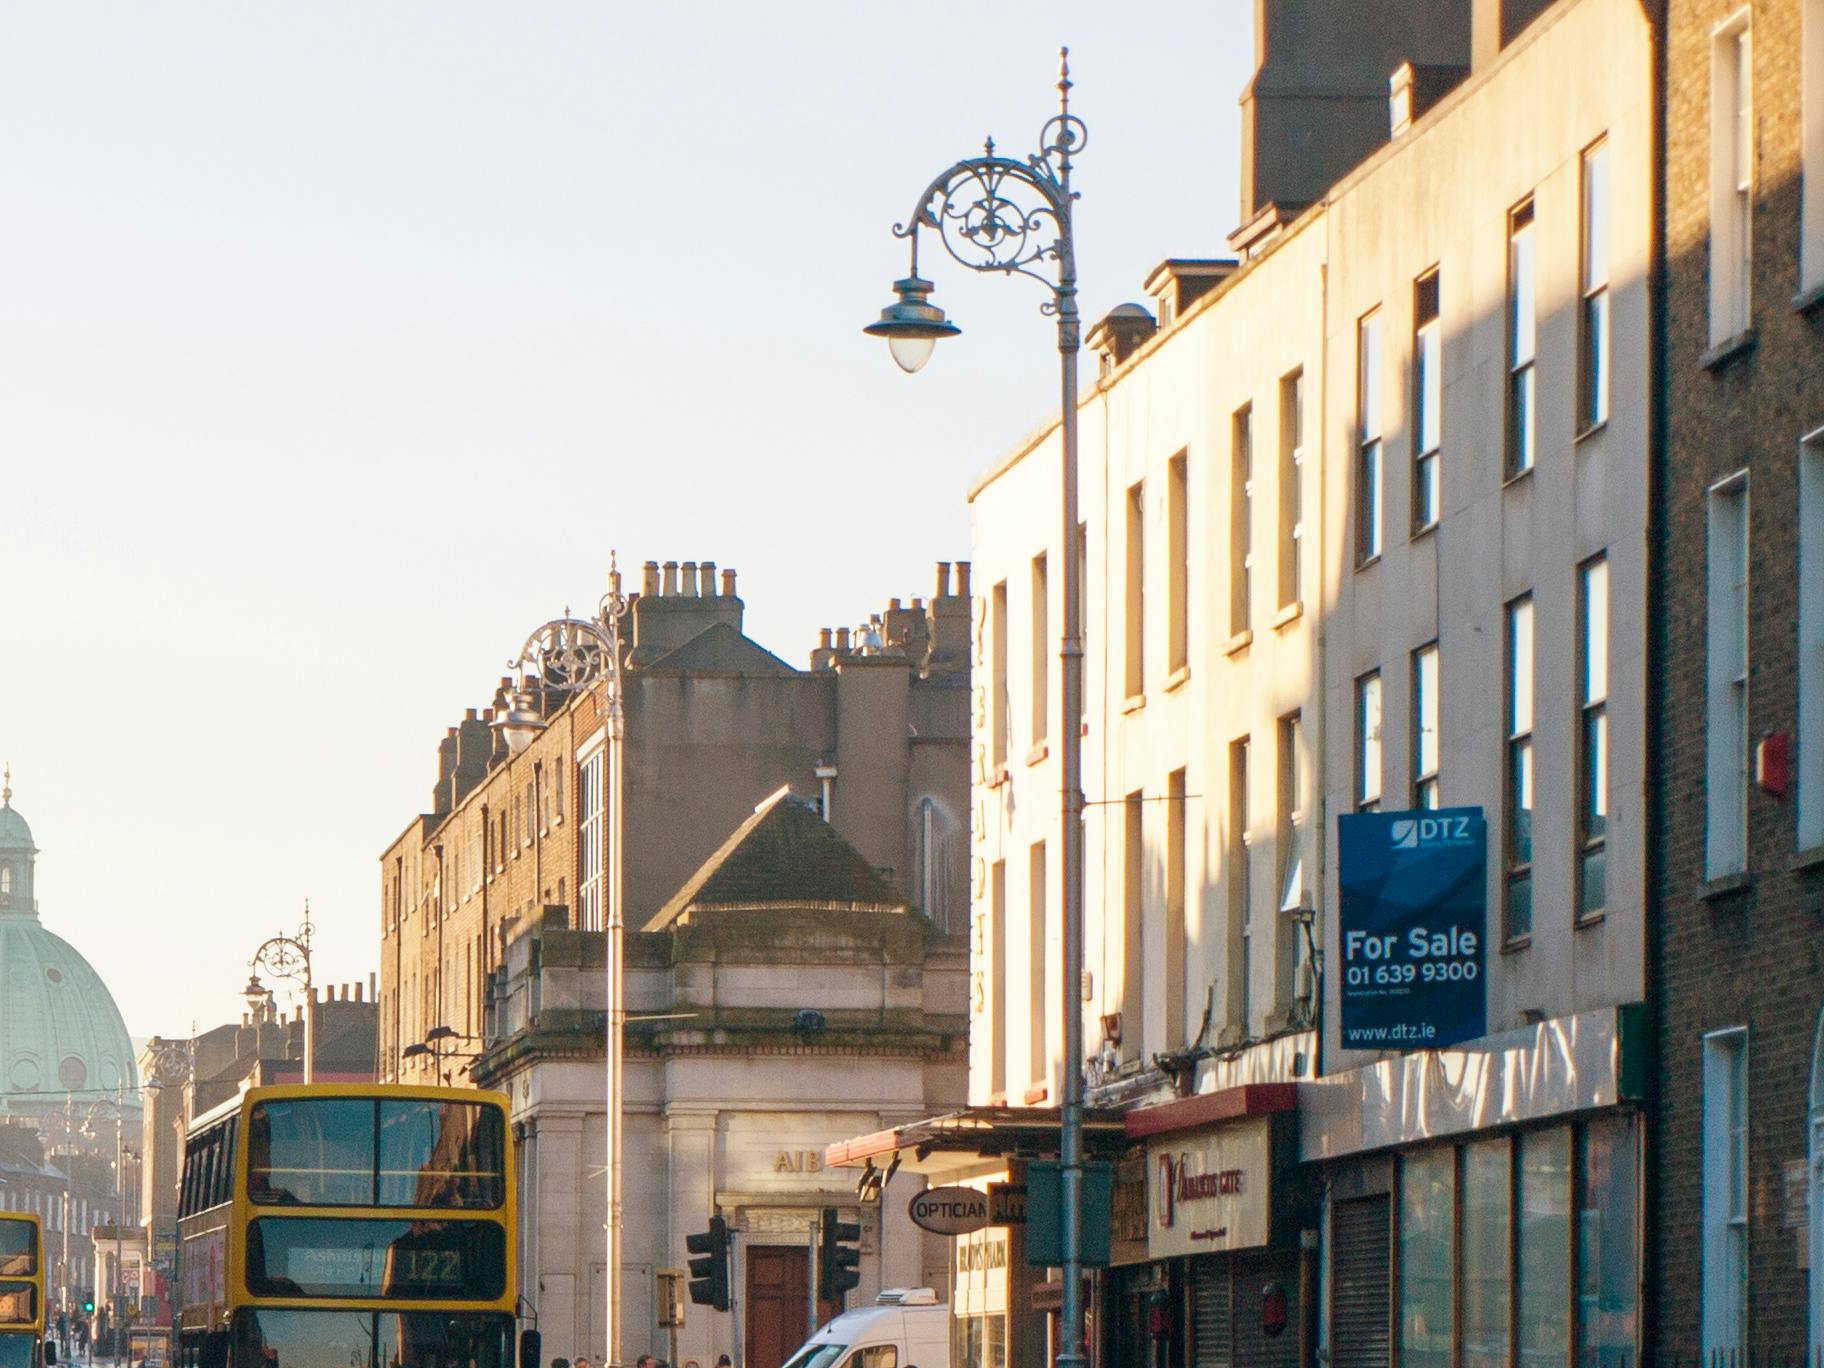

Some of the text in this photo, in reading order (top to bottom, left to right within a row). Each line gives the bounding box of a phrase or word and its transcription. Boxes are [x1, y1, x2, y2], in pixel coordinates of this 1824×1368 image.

[1420, 816, 1470, 840] DTZ
[1346, 926, 1478, 960] For Sale
[1348, 961, 1478, 985] 01 639 9300
[1348, 1023, 1436, 1041] www.dtz.ie
[775, 1151, 824, 1173] AIB
[408, 1250, 461, 1281] 122
